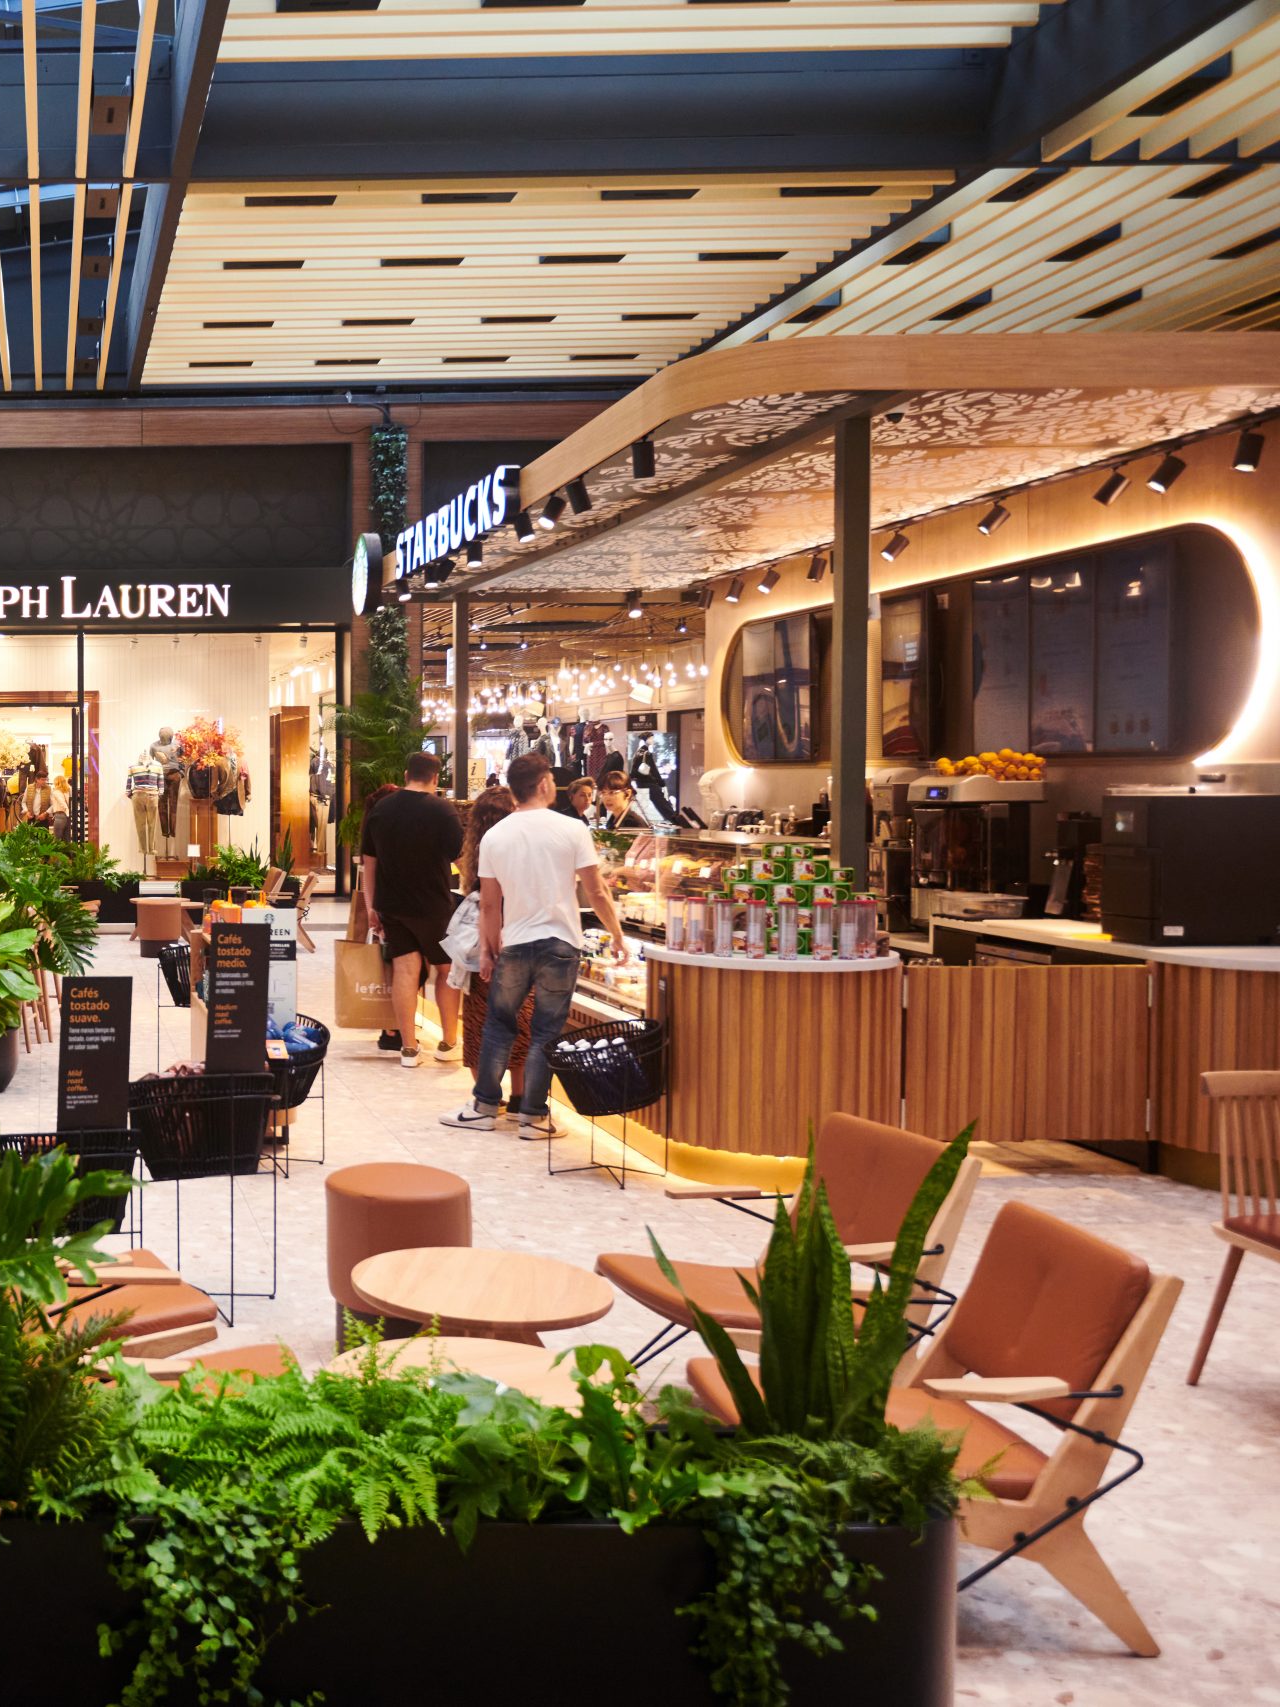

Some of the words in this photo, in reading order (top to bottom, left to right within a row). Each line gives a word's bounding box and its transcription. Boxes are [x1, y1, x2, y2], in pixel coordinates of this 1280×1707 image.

[396, 465, 507, 580] STARBUCKS
[61, 576, 231, 619] LAUREN
[217, 933, 242, 944] Cafés
[217, 946, 251, 956] tostado
[216, 958, 248, 968] medio.
[70, 987, 99, 998] Cafés
[70, 1000, 110, 1010] tostado
[69, 1014, 101, 1023] suave.
